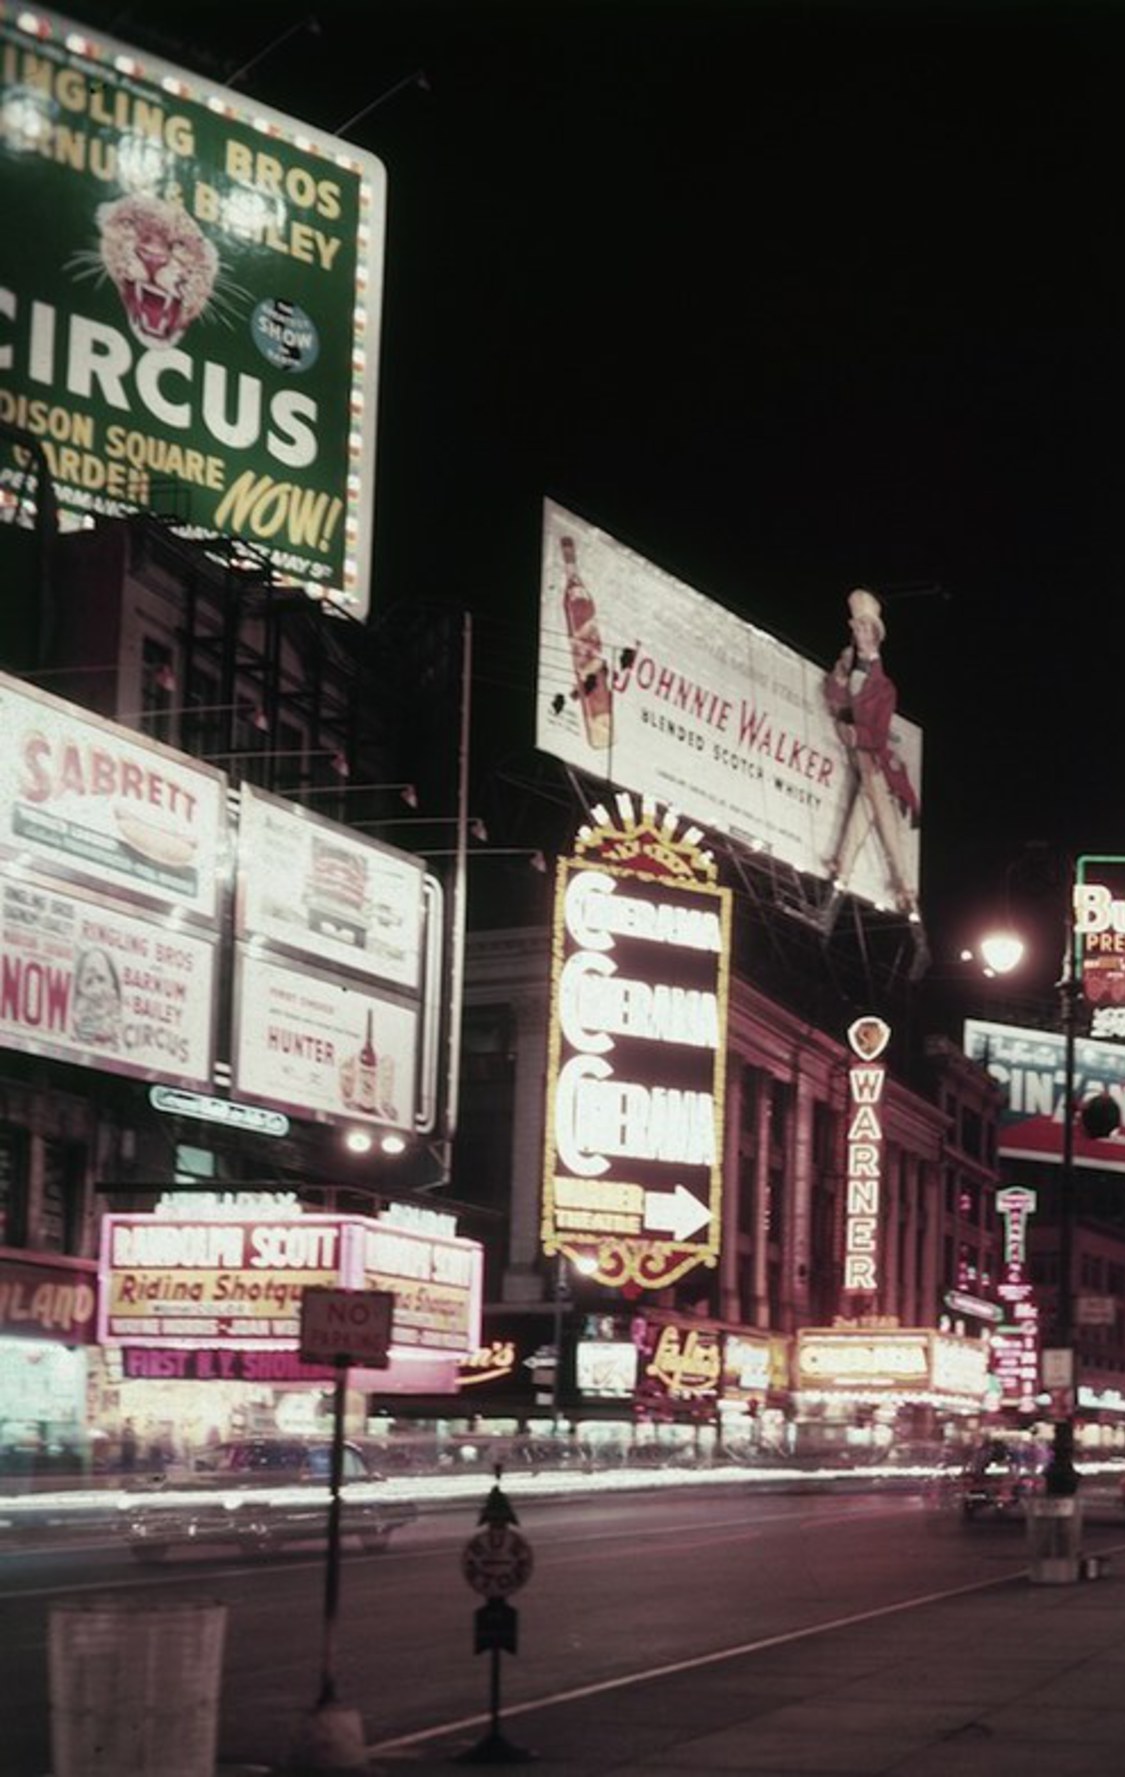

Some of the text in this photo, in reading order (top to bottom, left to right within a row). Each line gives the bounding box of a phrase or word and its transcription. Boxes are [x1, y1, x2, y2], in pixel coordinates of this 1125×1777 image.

[3, 44, 342, 220] INGLING BROS
[194, 180, 342, 271] BLEY
[0, 391, 226, 491] DISON SQUARE
[213, 469, 343, 553] NOW!
[611, 643, 733, 734] JOHNNIE
[738, 699, 836, 787] WALKER
[640, 708, 706, 752] BLENDED
[712, 744, 765, 781] SCOTCH
[19, 731, 197, 823] SABRETT
[1, 954, 72, 1032] NOW
[123, 1023, 189, 1063] CIRCUS
[267, 1026, 336, 1067] HUNTER
[845, 1068, 884, 1290] WARNER
[250, 1226, 338, 1268] SCOTT
[119, 1275, 204, 1304] Riding
[213, 1275, 303, 1310] Shotgu
[328, 1303, 369, 1325] NO
